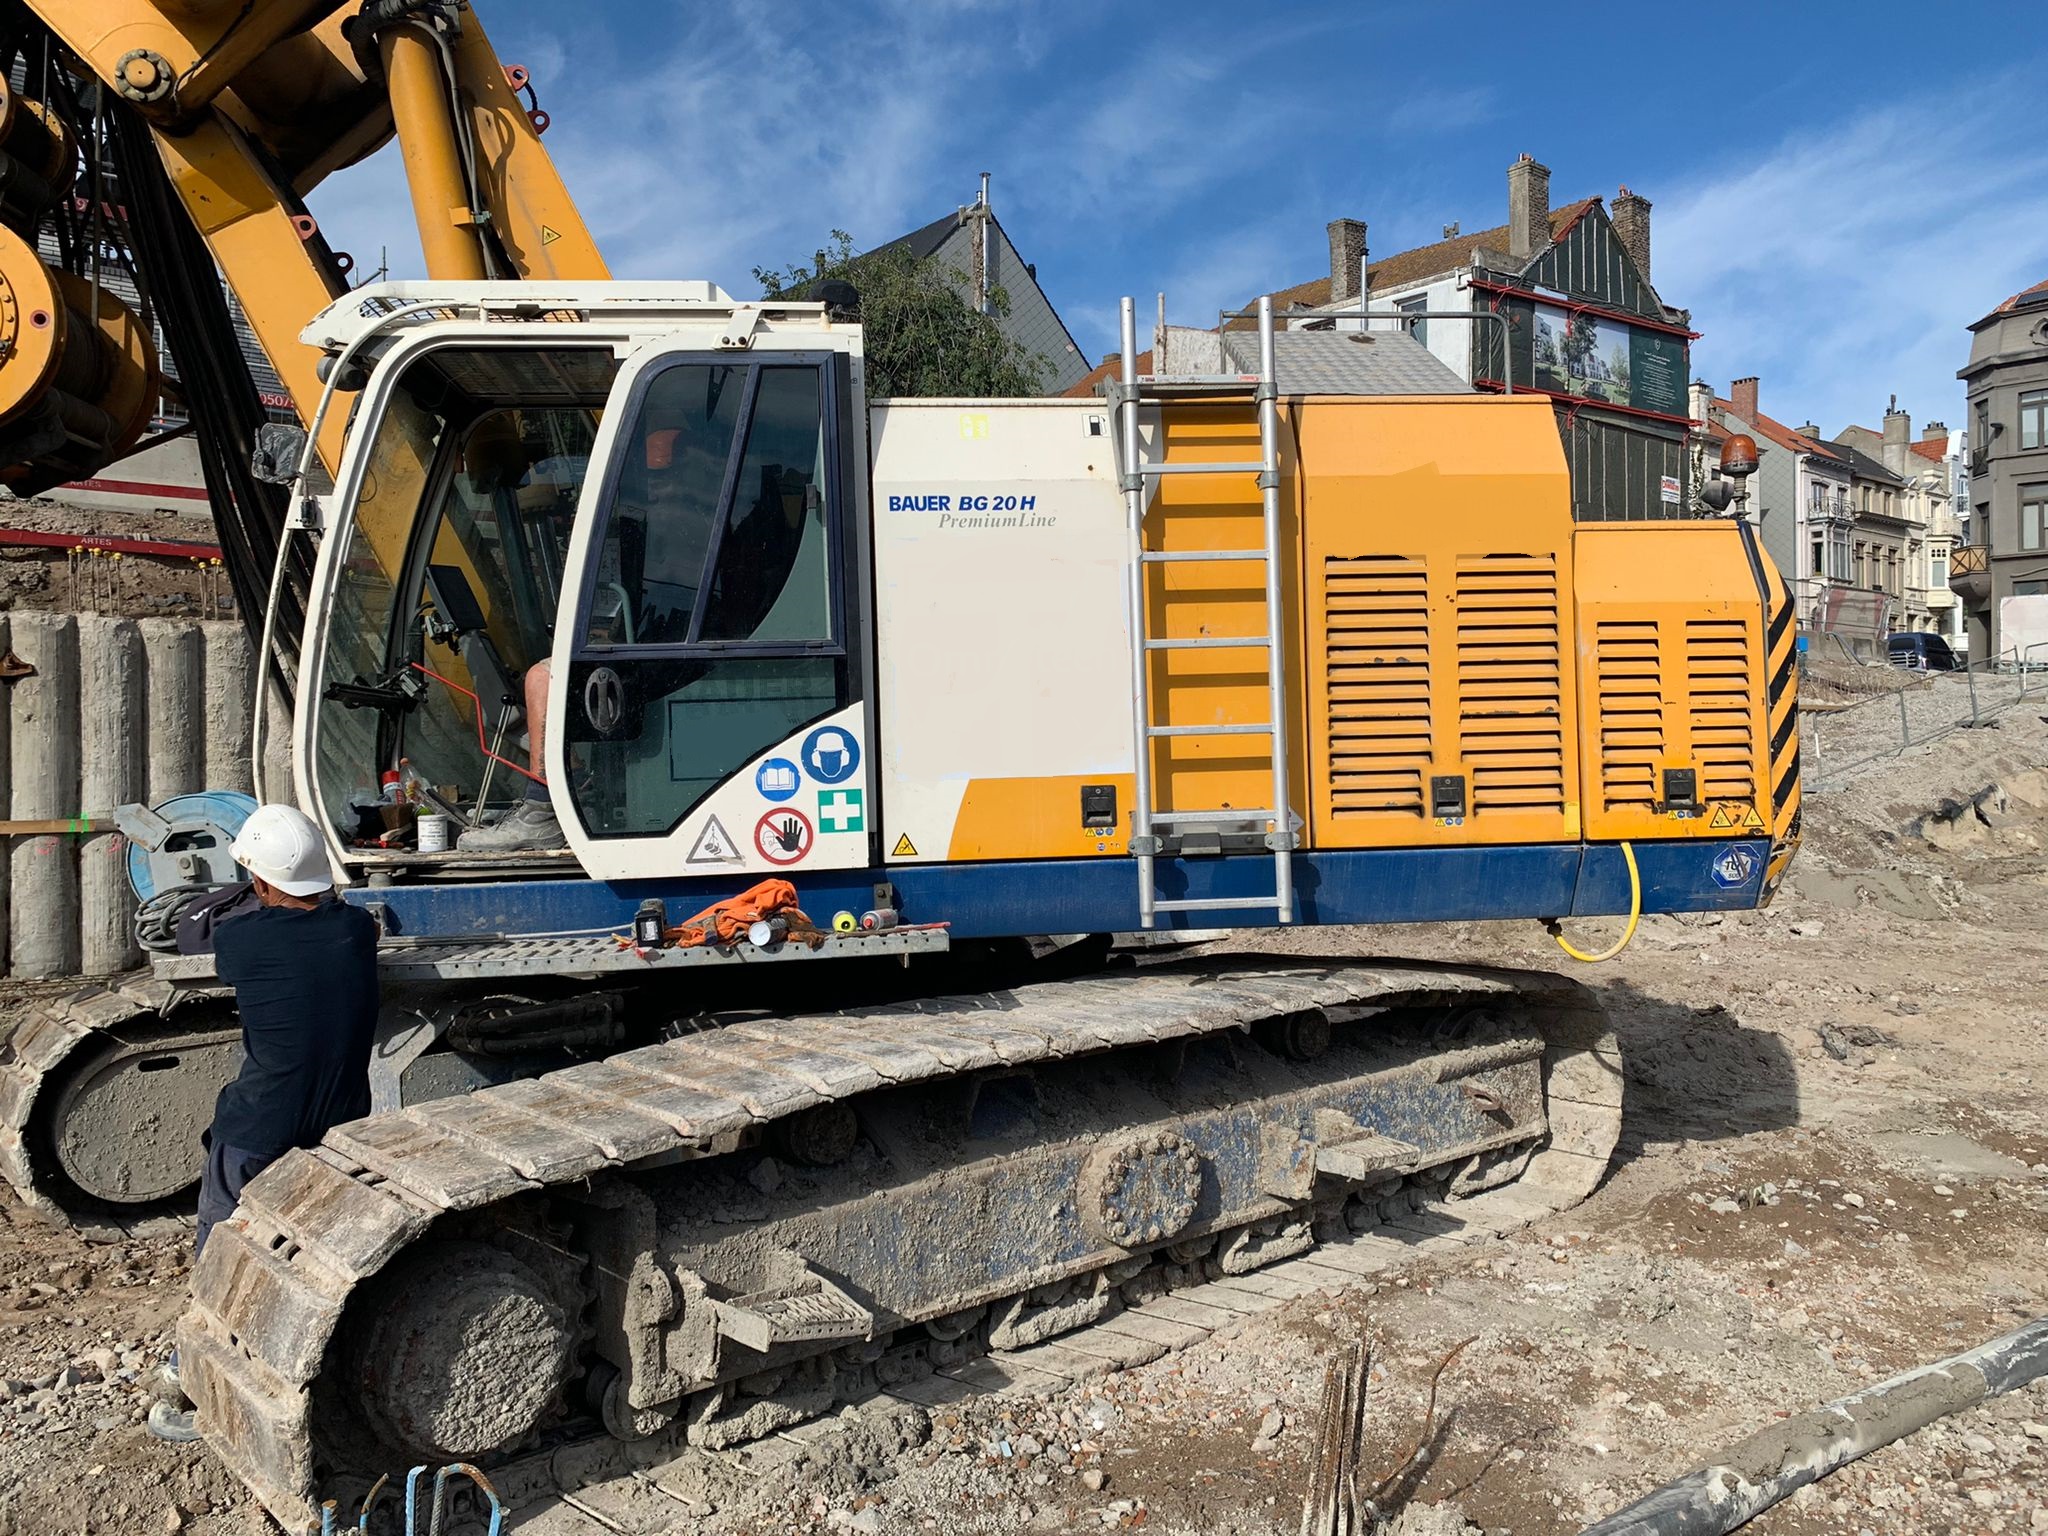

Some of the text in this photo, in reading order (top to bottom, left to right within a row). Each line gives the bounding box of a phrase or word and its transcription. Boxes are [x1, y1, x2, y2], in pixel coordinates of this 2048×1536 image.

[889, 496, 950, 512] BAUER
[958, 496, 988, 511] BG
[81, 537, 112, 546] ARTES
